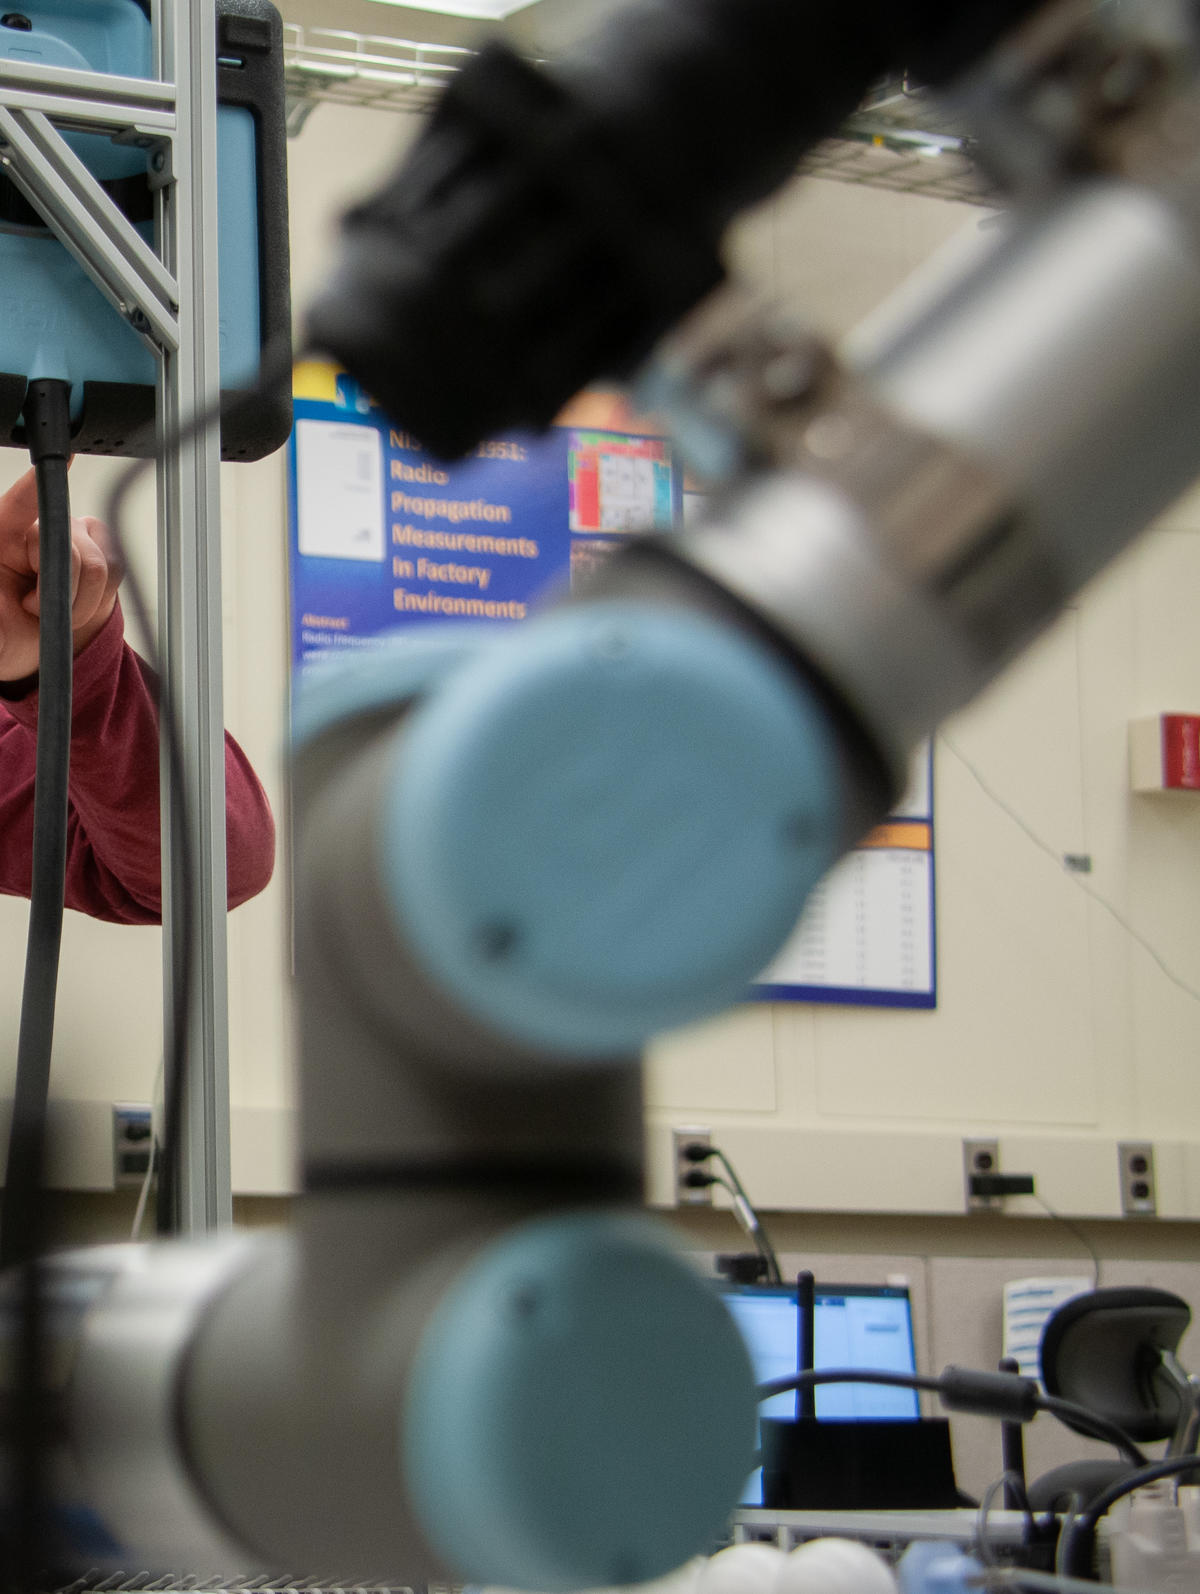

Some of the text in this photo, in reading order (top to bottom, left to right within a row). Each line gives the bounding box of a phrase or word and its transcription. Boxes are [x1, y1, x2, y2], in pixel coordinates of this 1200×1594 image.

[390, 459, 449, 486] Radio
[391, 490, 512, 523] Propagation
[392, 524, 540, 558] Measurements
[393, 556, 492, 589] In Factory
[394, 588, 527, 619] Environments
